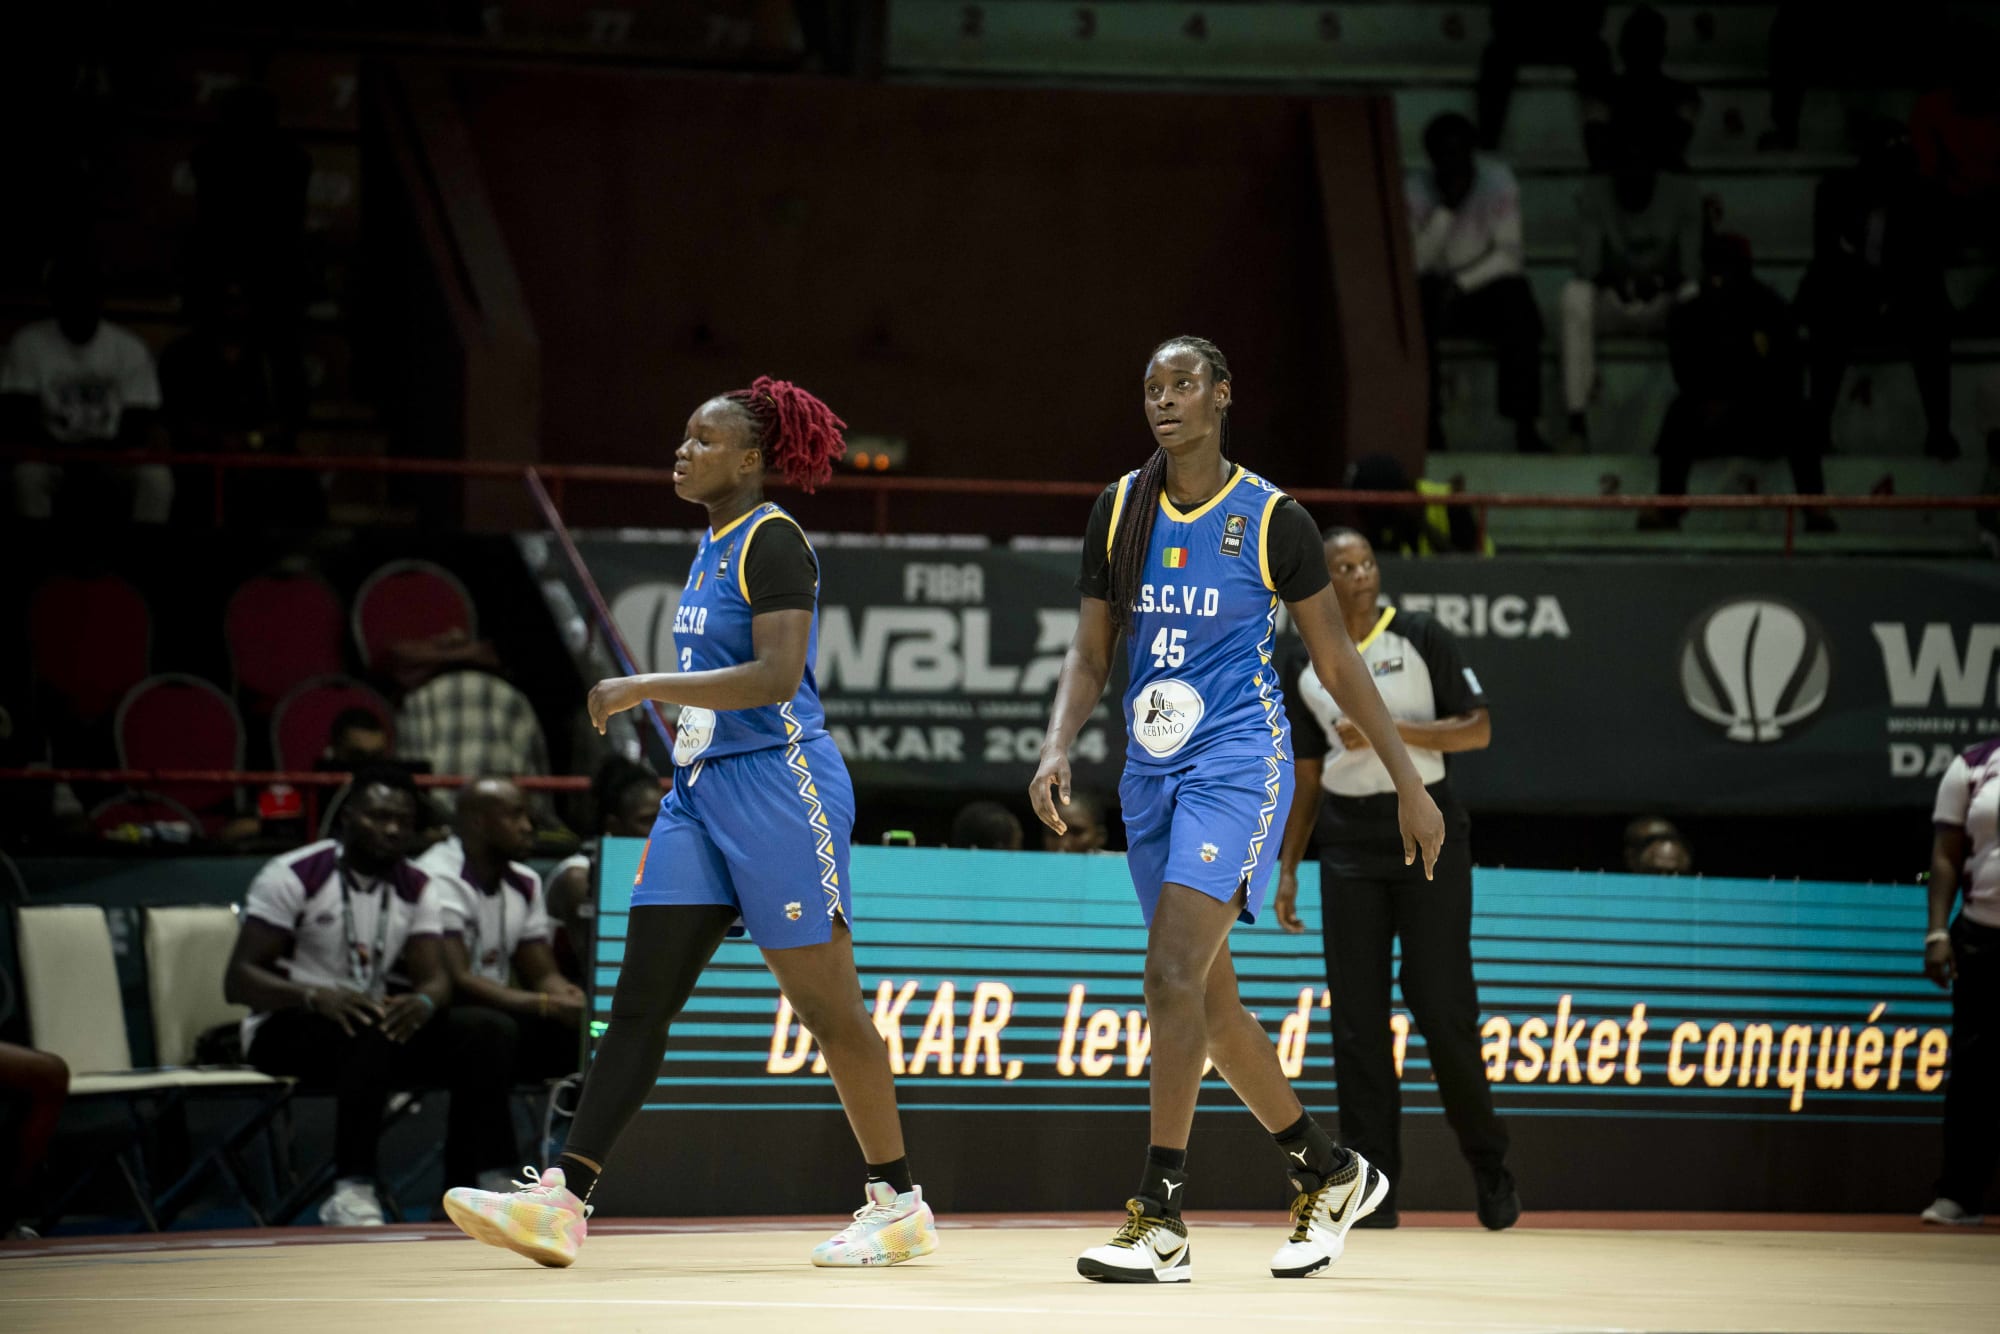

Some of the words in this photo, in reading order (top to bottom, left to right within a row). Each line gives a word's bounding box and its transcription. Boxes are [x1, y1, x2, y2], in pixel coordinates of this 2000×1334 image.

[904, 562, 984, 601] FIBA
[1131, 584, 1219, 617] .S.C.V.D
[1377, 593, 1571, 638] RICA
[1151, 627, 1188, 668] 45
[1870, 622, 2000, 708] W
[829, 725, 966, 764] AKAR
[983, 726, 1108, 764] 204
[1143, 722, 1184, 737] KEBIMO
[1889, 742, 1957, 778] DA
[766, 980, 1023, 1080] DKAR,
[1481, 995, 1648, 1086] asket
[1667, 1002, 1950, 1112] conquére
